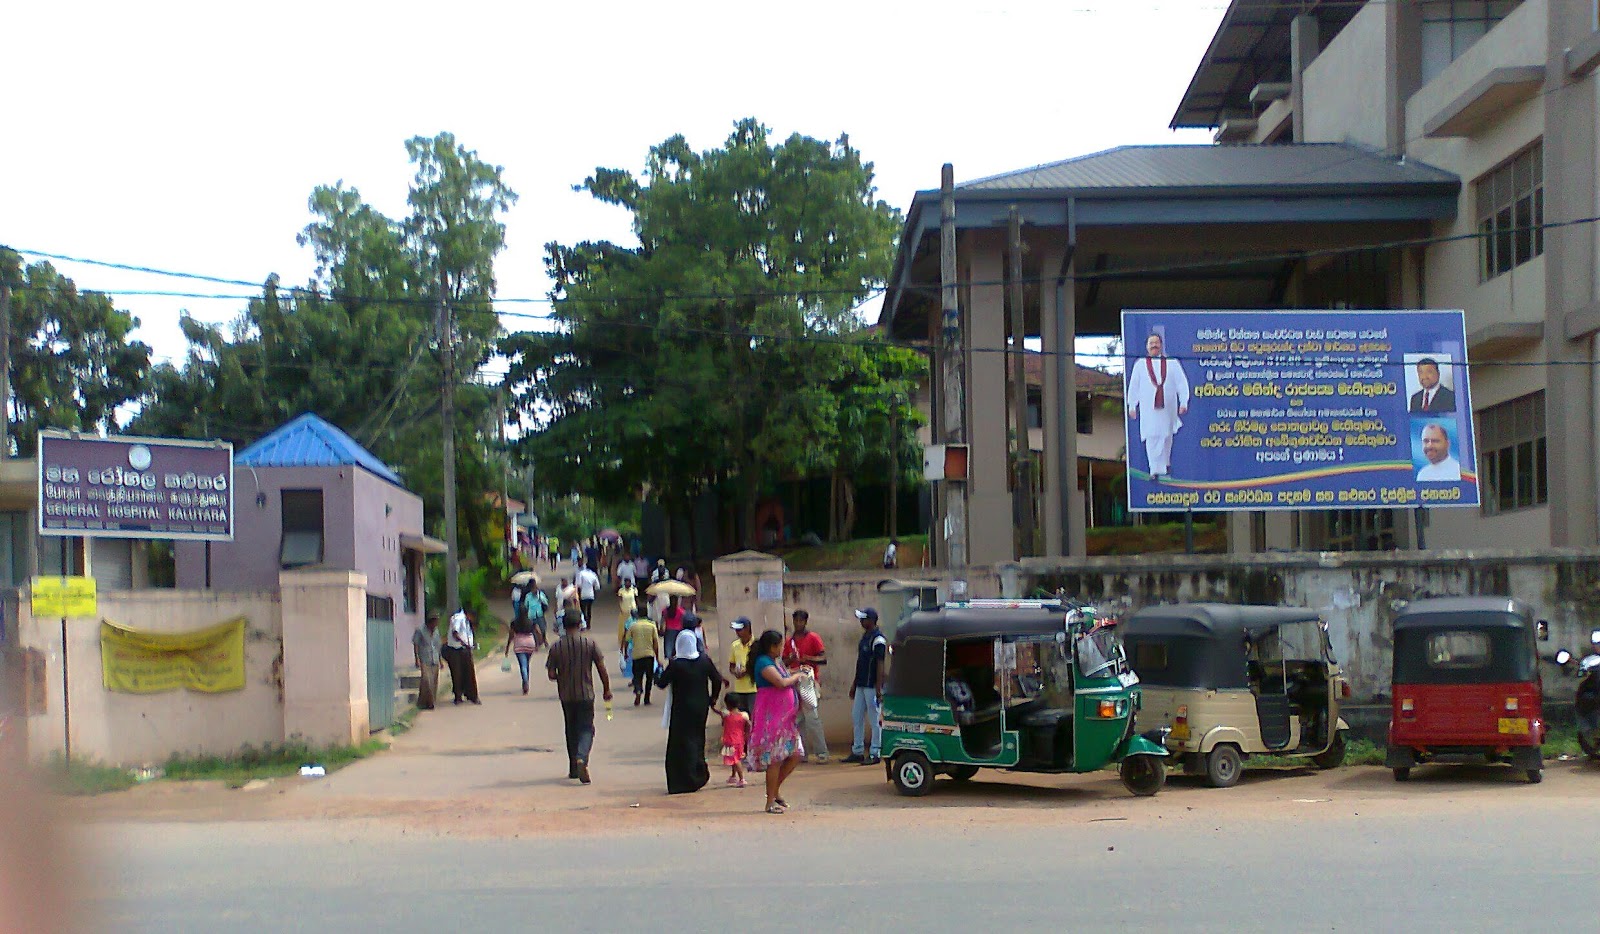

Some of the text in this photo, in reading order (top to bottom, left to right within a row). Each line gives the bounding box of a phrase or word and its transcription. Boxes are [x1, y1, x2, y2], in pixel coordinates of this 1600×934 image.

[1195, 383, 1239, 398] අතිගරු
[1243, 382, 1283, 398] මහින්ද
[1338, 382, 1397, 398] මැතිතුමාට
[1345, 434, 1397, 448] මැතිතුමාට
[46, 465, 227, 491] මහ රෝහල කළුතර
[1204, 490, 1220, 503] රට
[46, 503, 227, 522] GENERAL HOSPITAL KALUTARA
